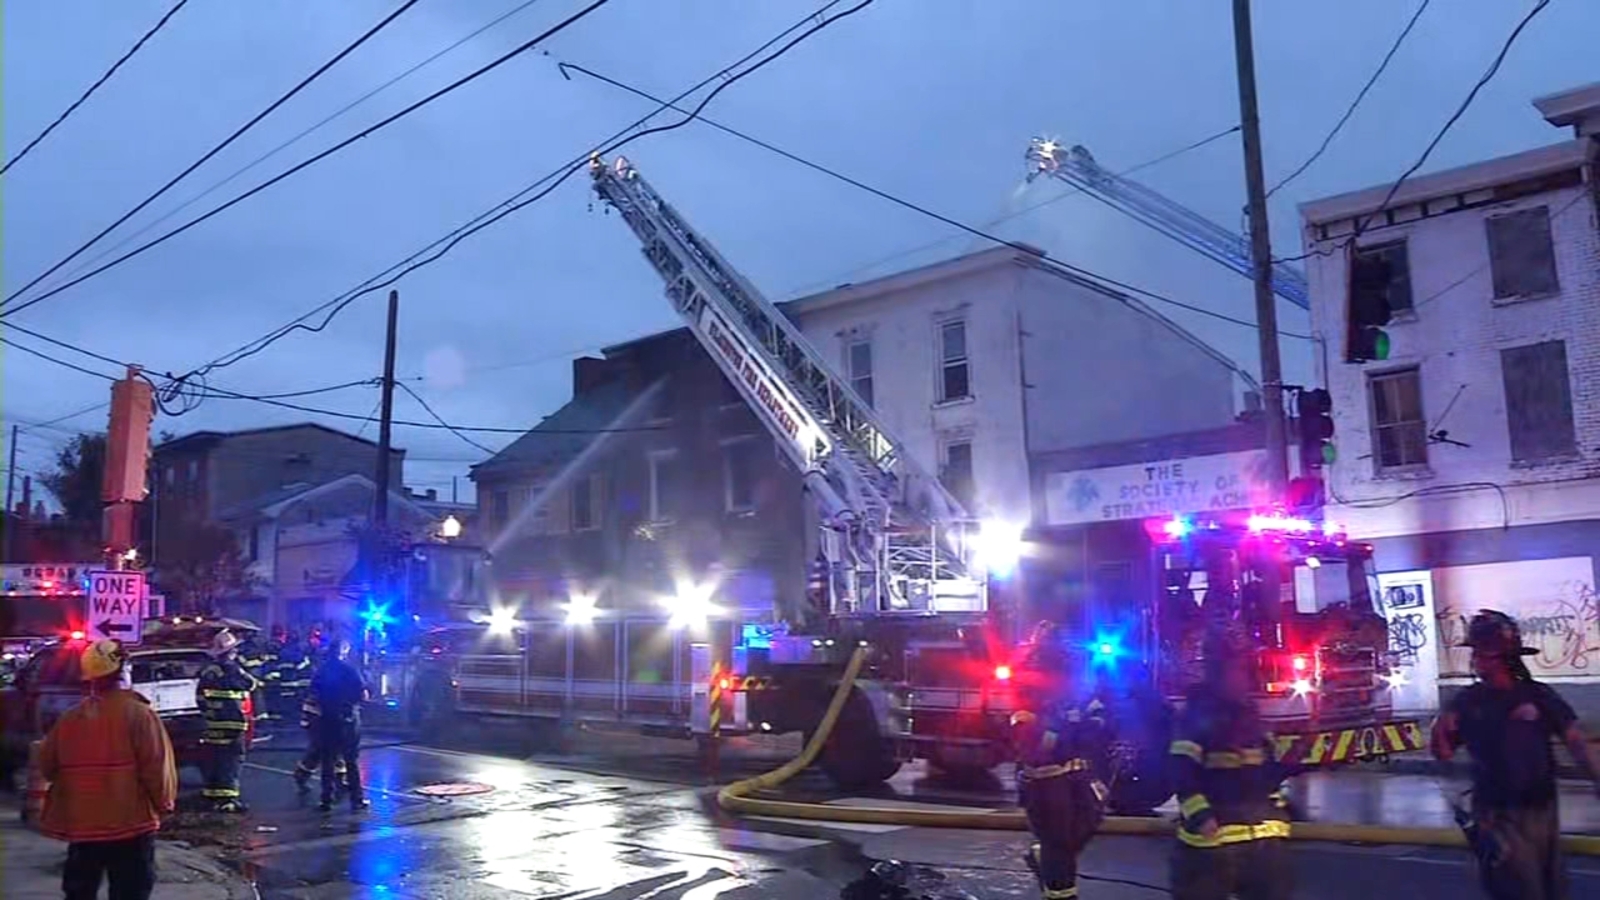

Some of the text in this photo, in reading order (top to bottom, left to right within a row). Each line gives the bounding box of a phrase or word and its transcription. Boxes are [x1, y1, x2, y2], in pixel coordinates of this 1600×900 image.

[1144, 463, 1184, 481] THE
[1119, 474, 1240, 499] SOCIETY OF
[94, 577, 136, 595] ONE
[93, 597, 136, 615] WAY
